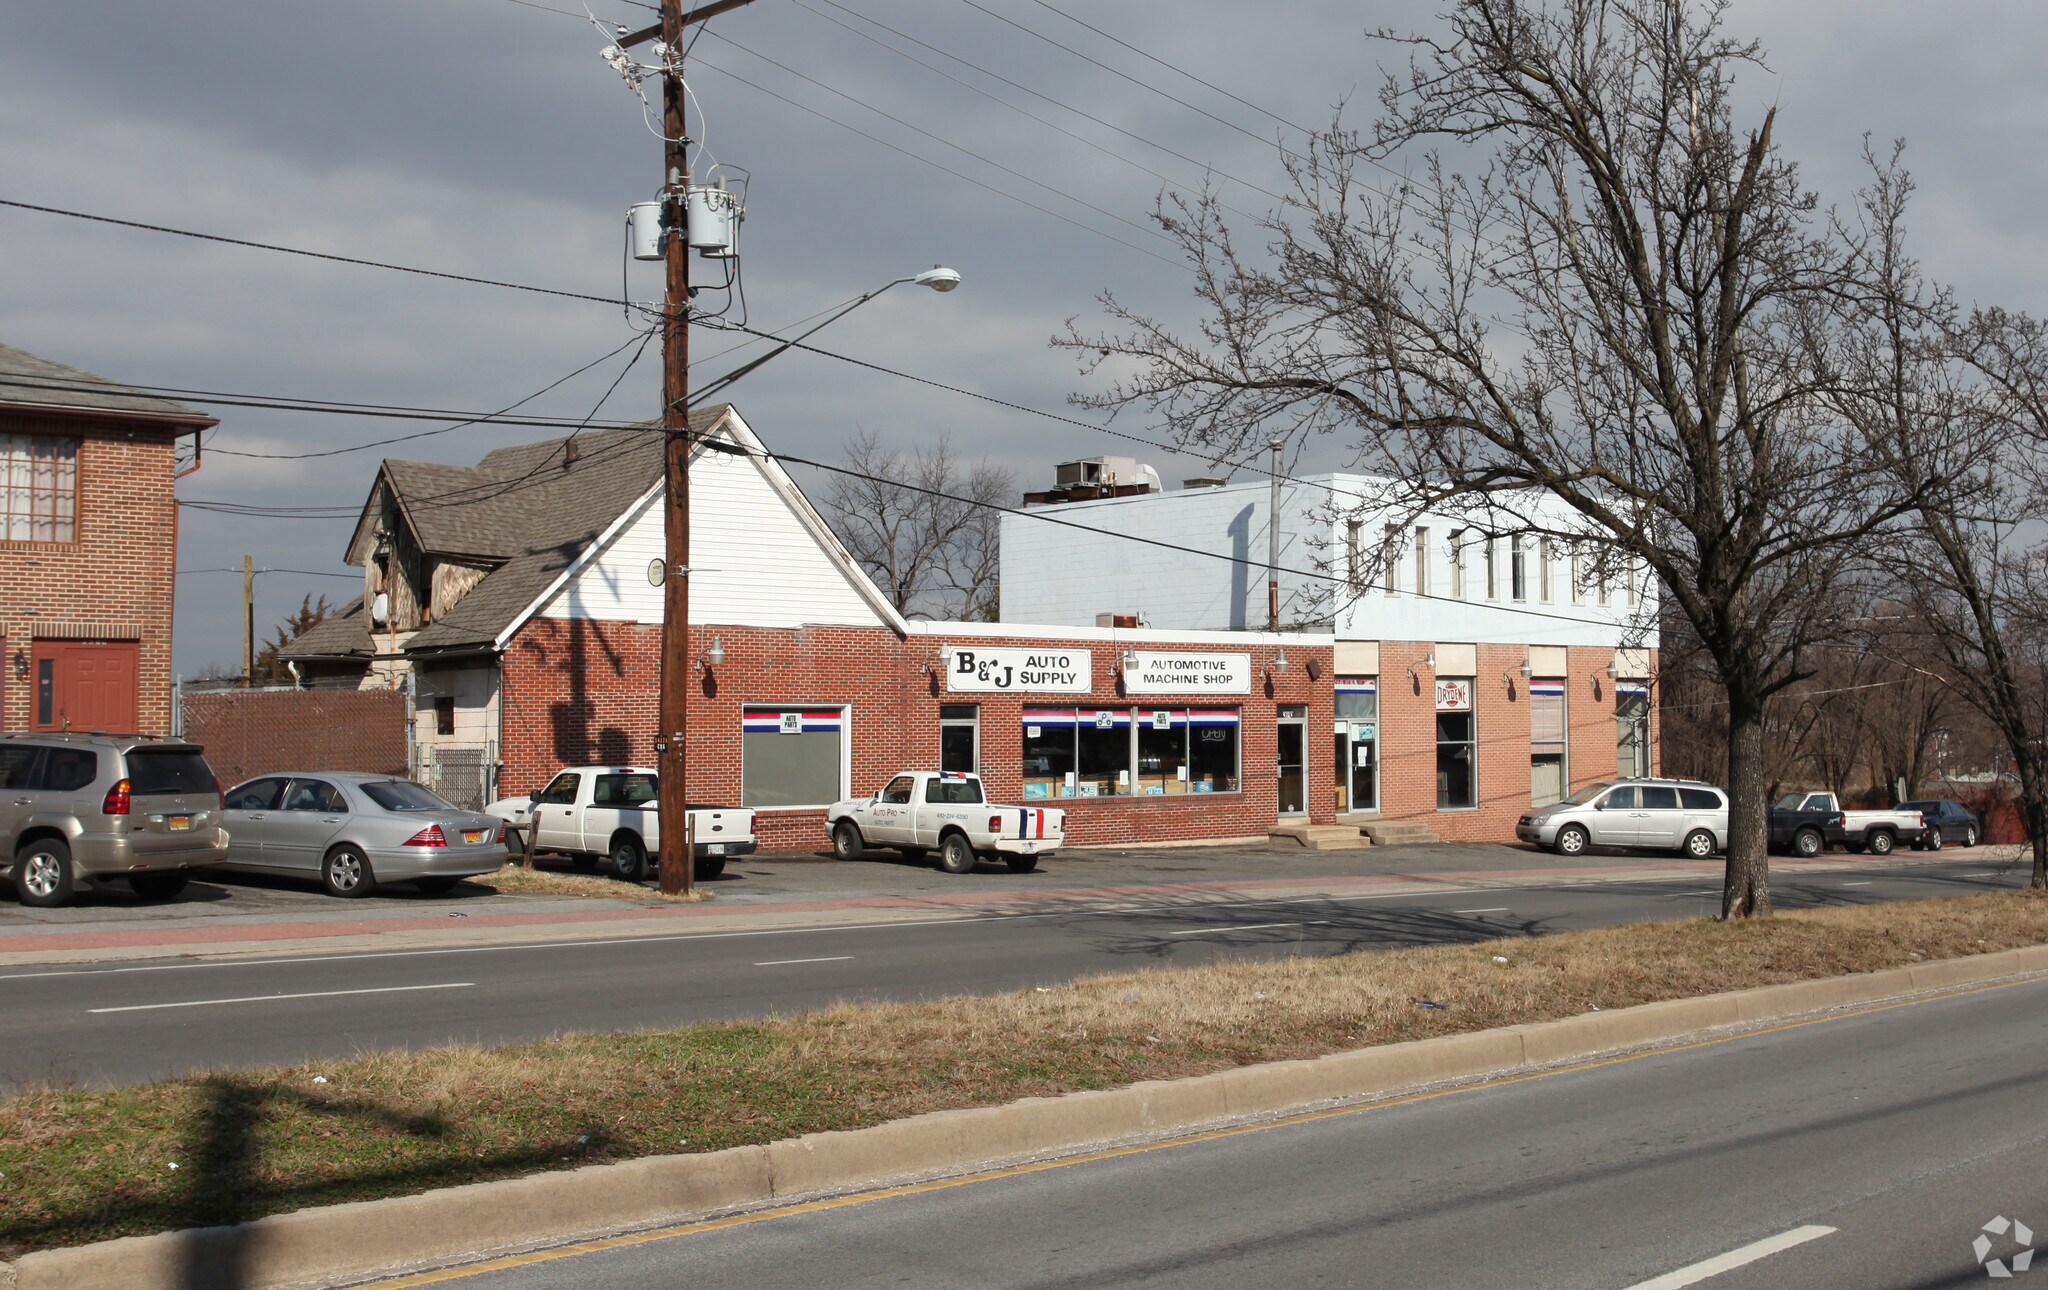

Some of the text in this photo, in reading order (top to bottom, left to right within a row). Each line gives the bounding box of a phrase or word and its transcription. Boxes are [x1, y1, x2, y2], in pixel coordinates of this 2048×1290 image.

[1025, 655, 1070, 668] AUTO
[1150, 659, 1227, 671] AUTOMOTIVE
[1020, 671, 1077, 685] SUPPLY
[1143, 674, 1233, 684] MACHINE SHOP
[1437, 684, 1467, 705] DRYDENE
